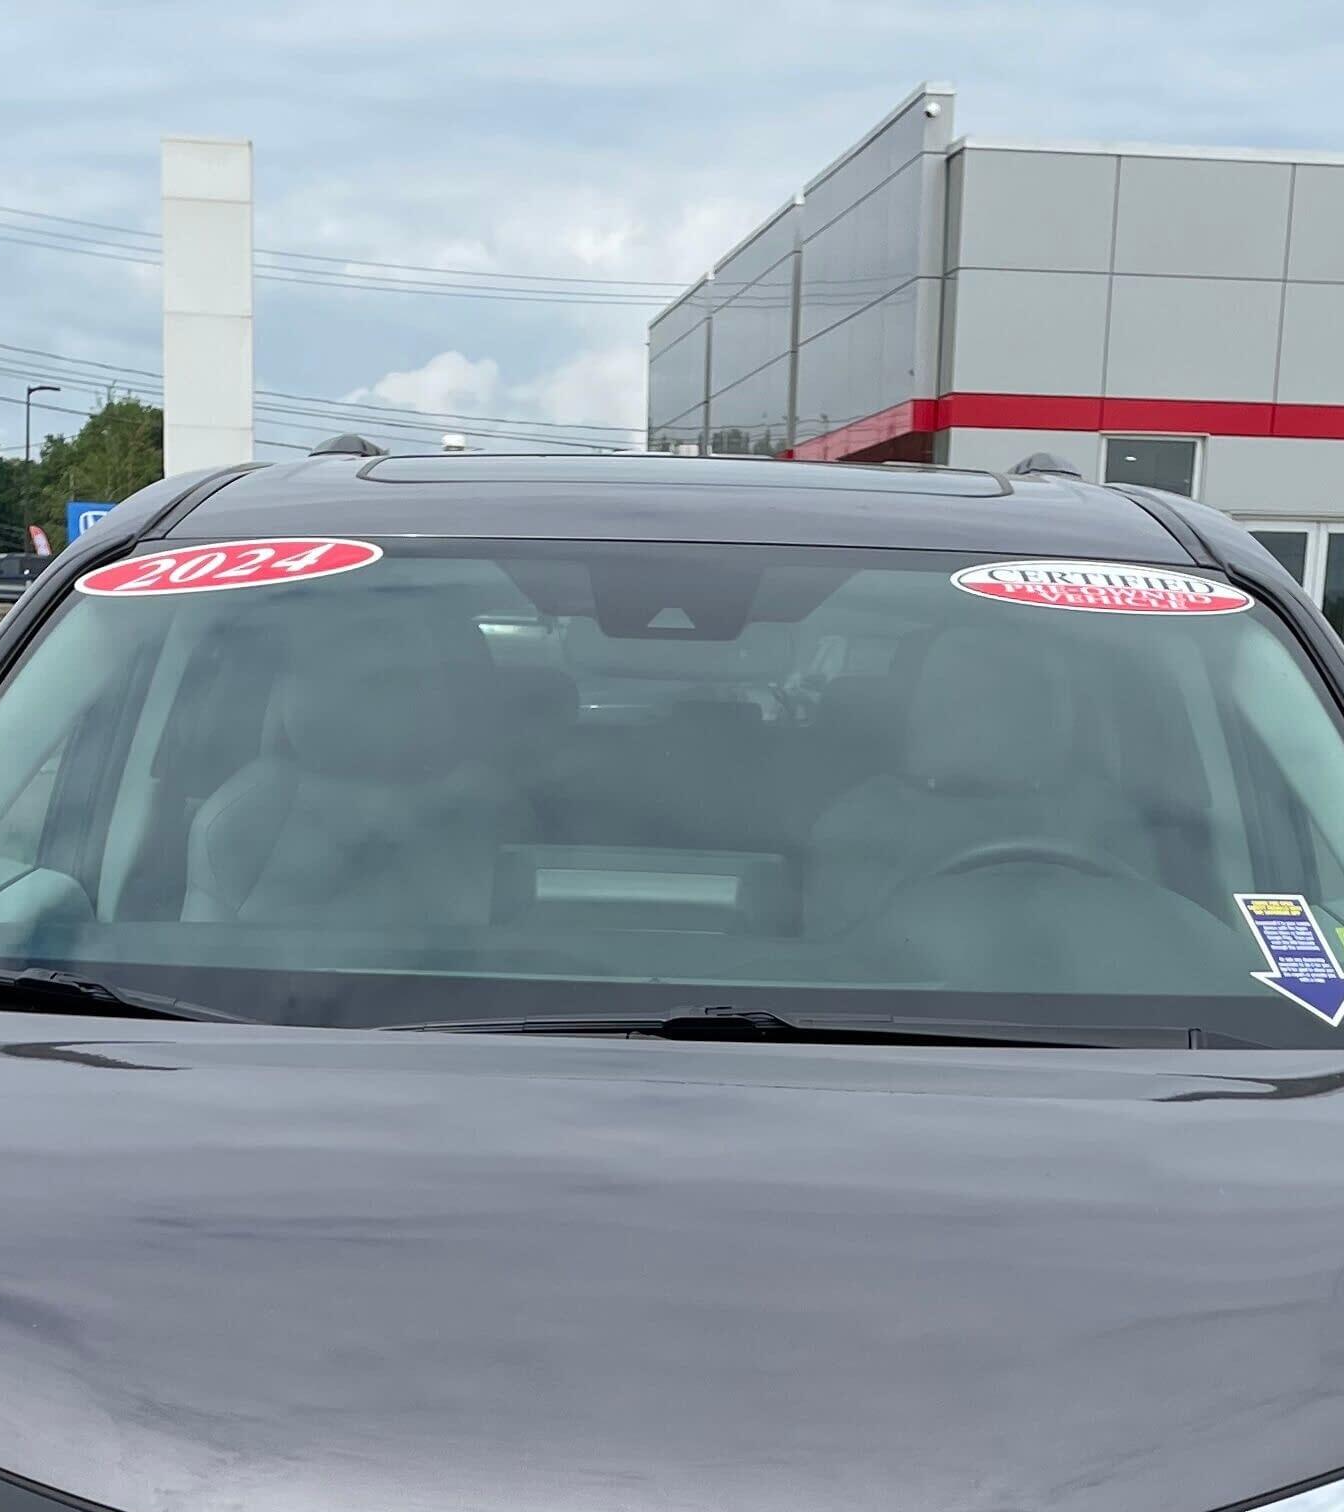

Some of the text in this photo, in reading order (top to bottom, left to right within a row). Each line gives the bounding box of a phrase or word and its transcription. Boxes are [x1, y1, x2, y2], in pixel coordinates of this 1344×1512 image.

[113, 543, 336, 591] 2024
[987, 568, 1215, 595] CERTIFIED
[1004, 582, 1212, 605] PRE-OWNED
[1039, 588, 1190, 611] VEHICLE
